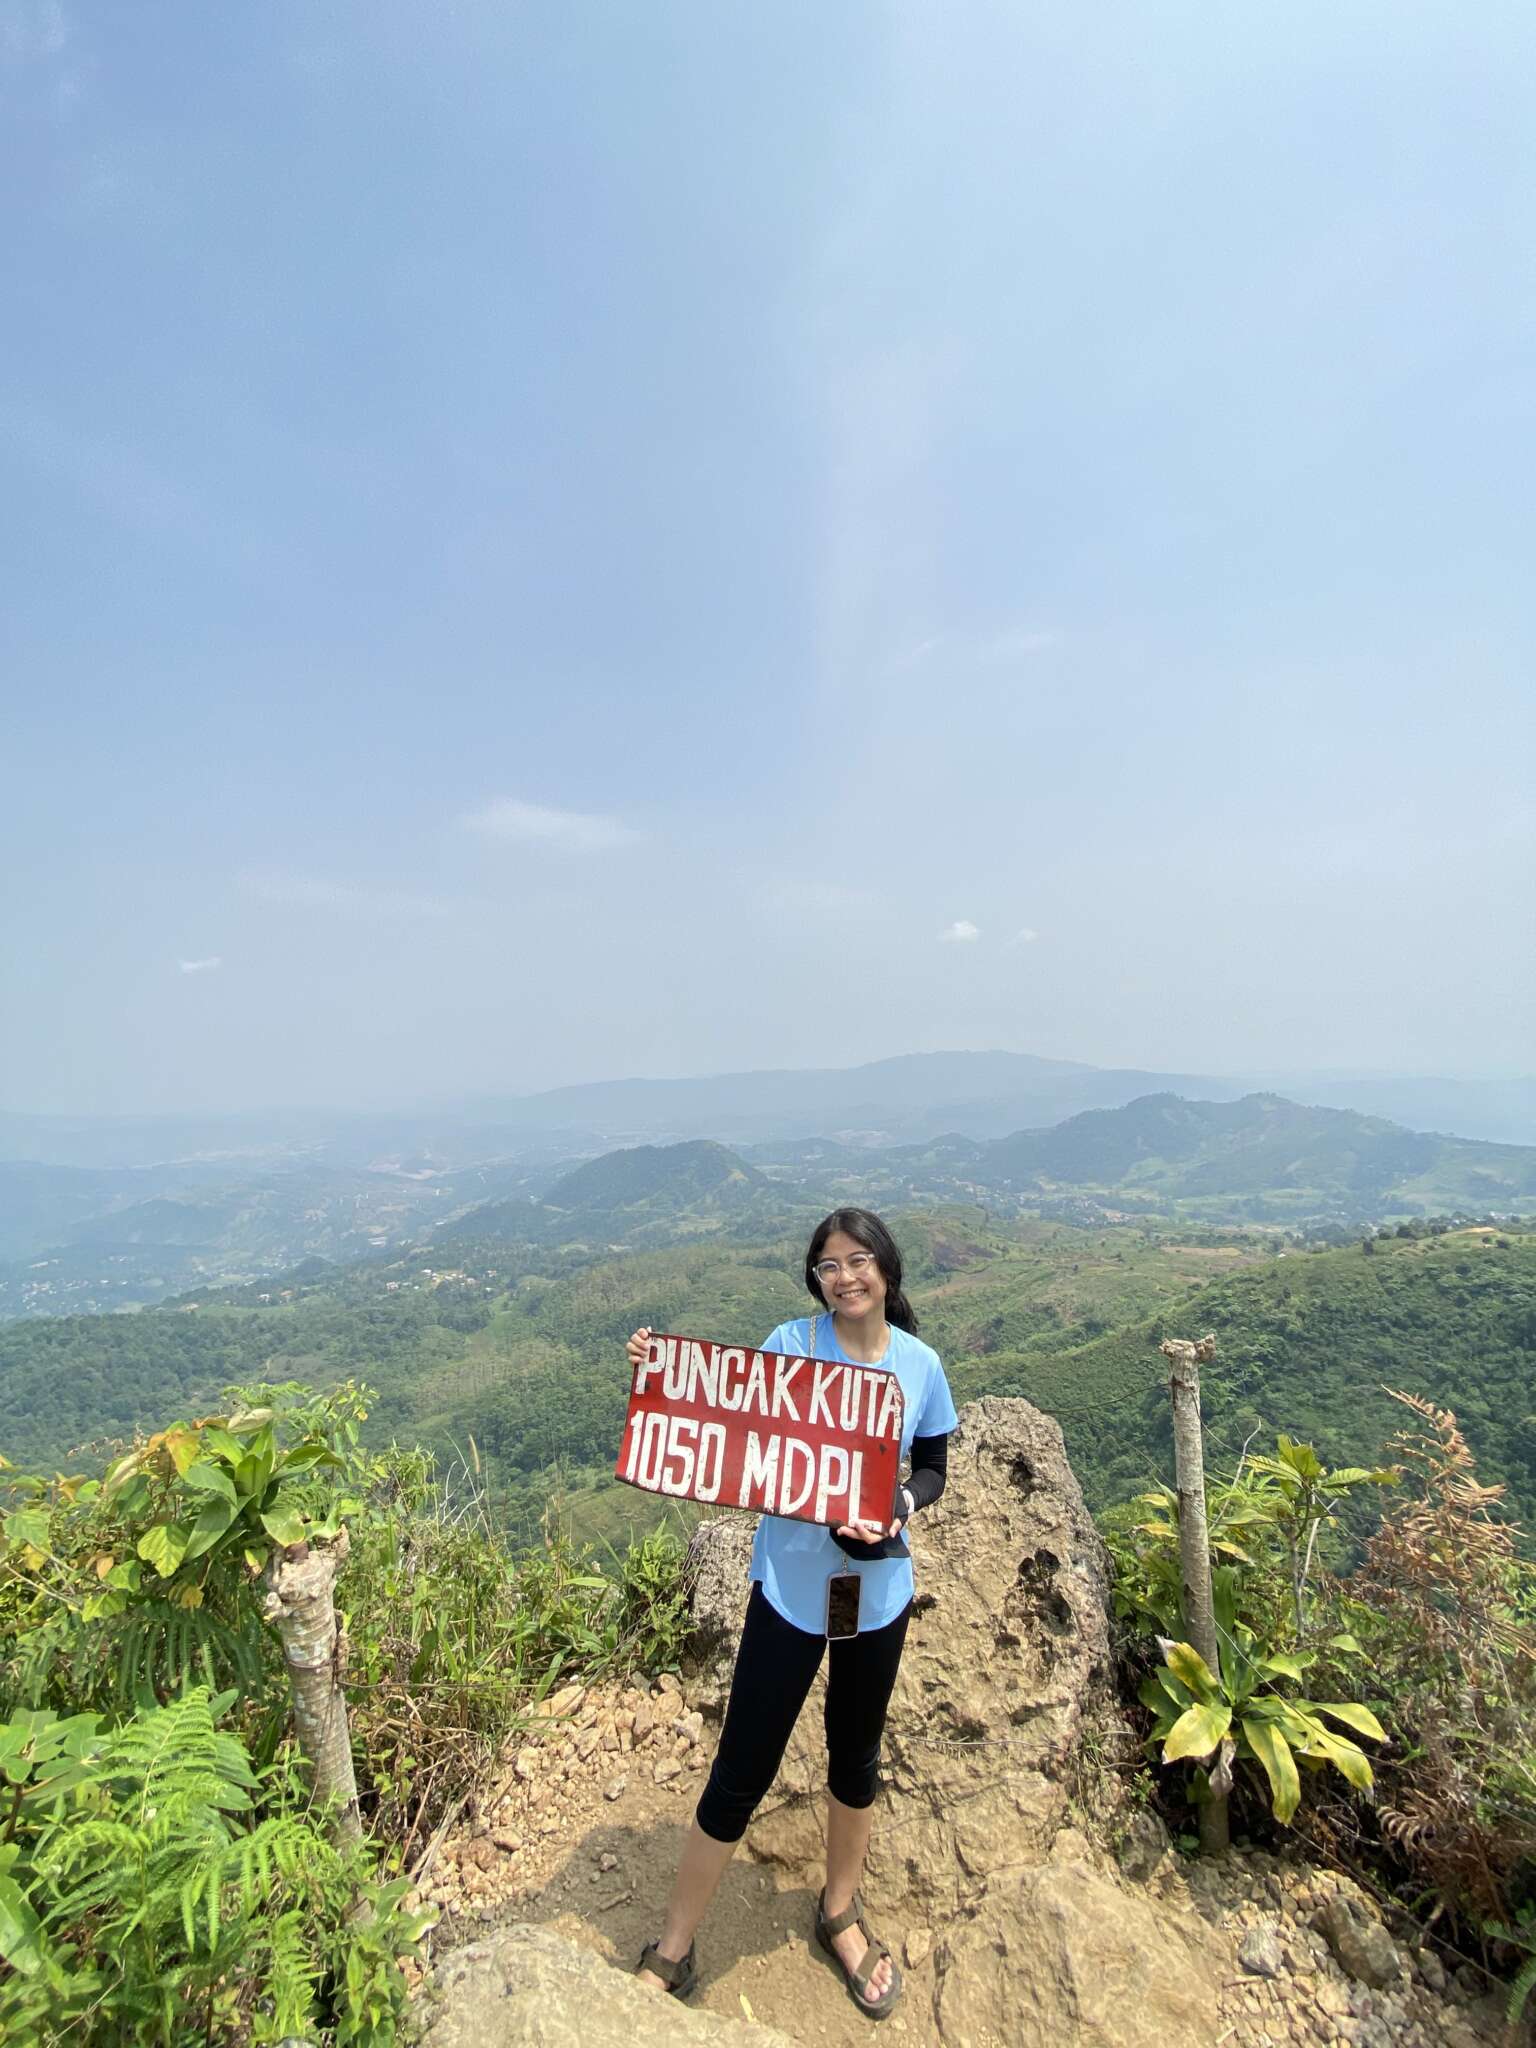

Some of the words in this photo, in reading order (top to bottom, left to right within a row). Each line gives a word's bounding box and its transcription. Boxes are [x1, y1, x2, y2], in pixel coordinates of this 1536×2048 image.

[635, 1337, 804, 1422] PUNCAK
[809, 1361, 901, 1440] KUTA
[626, 1410, 726, 1502] 1050
[739, 1431, 882, 1533] MDPL
